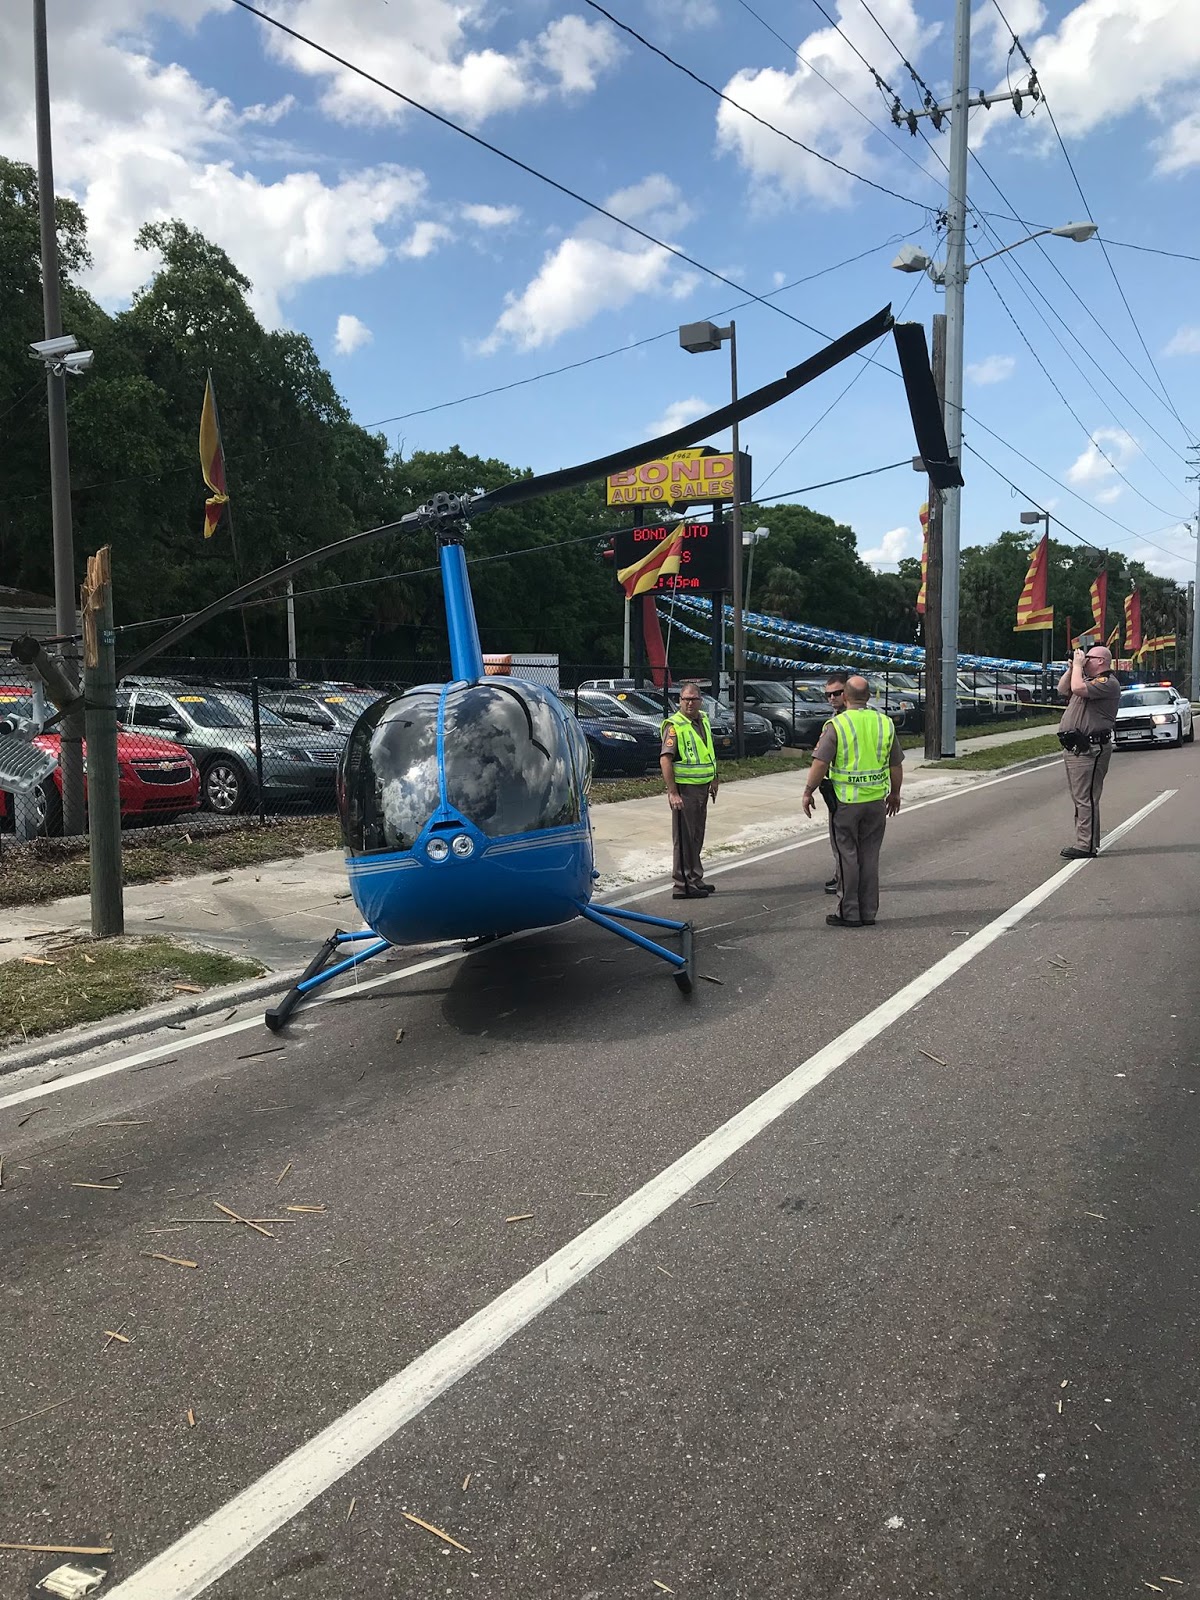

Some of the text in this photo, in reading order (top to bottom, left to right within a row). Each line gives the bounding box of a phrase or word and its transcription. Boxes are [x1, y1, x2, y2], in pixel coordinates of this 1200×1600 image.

[610, 457, 734, 487] BOND
[611, 480, 734, 503] AUTO SALES
[633, 525, 708, 541] BOND UTO
[651, 575, 700, 589] :45pm
[848, 775, 867, 783] STATE
